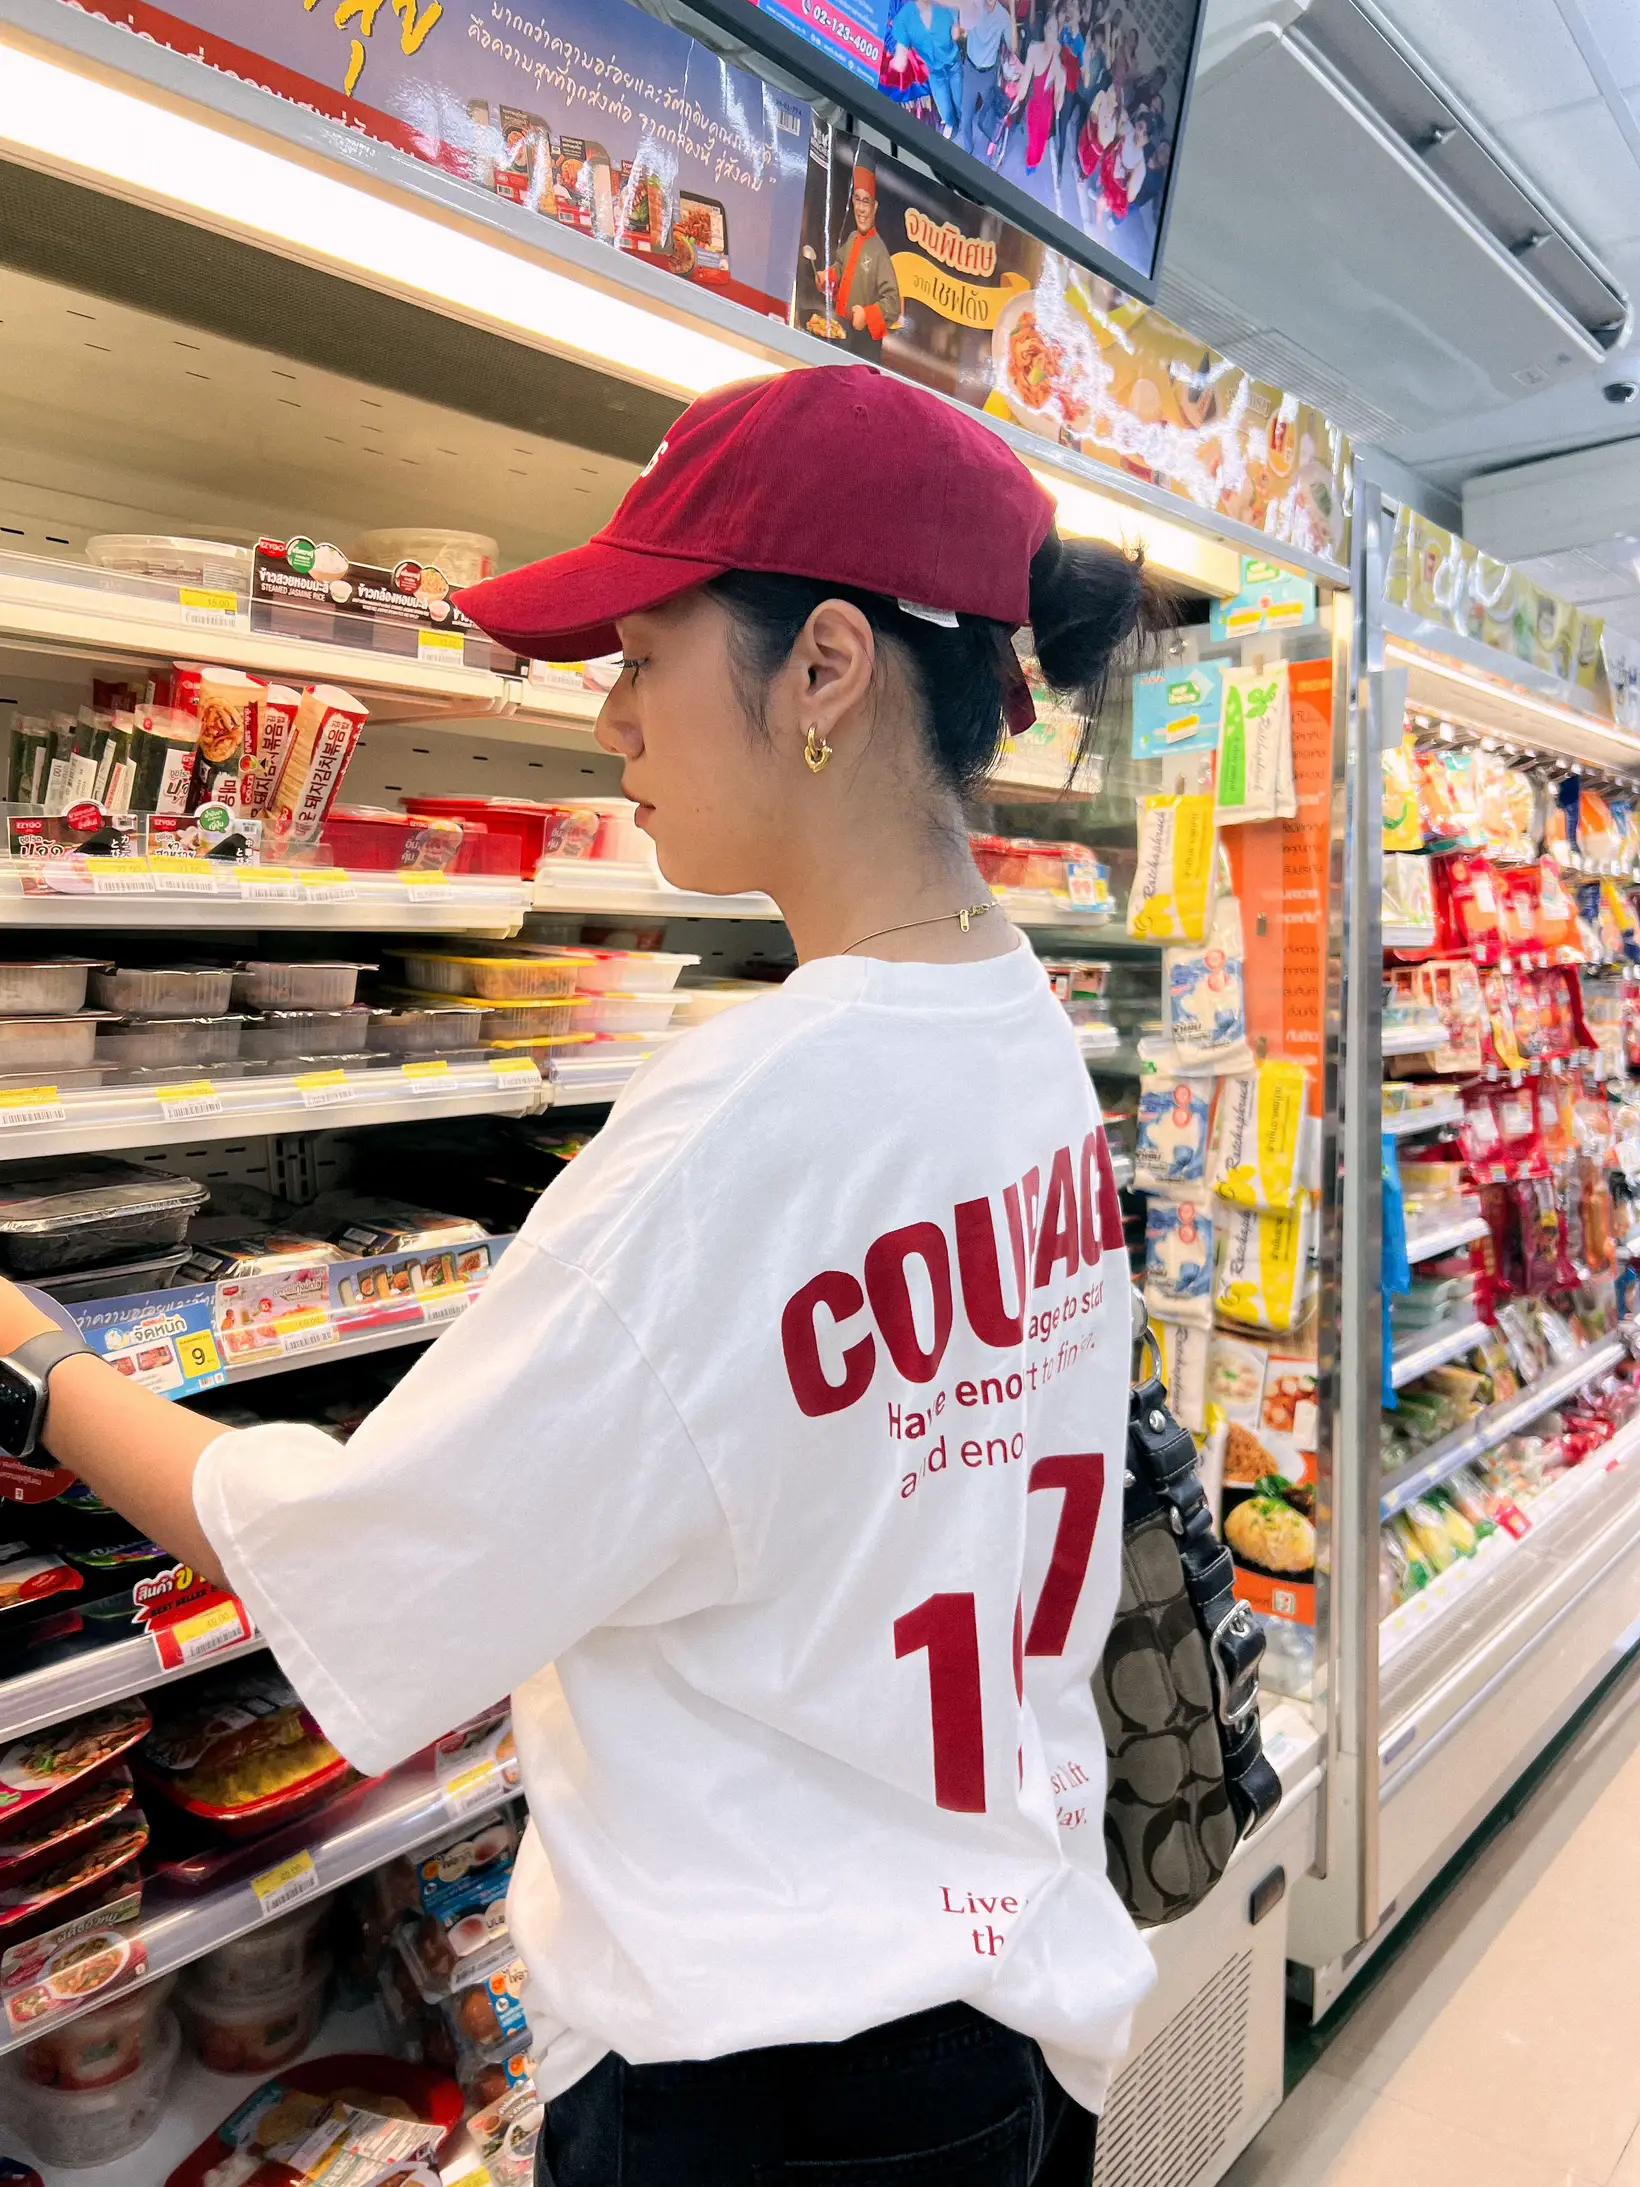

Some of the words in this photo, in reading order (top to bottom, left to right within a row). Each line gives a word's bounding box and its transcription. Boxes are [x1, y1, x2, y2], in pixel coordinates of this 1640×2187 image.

[813, 6, 879, 61] 02-123-4000
[907, 211, 995, 272] จานพิเศษ
[304, 728, 347, 810] 돼지김치볶음
[15, 821, 43, 830] EZYGO
[134, 1314, 187, 1343] จัดหนัก
[191, 1347, 206, 1366] 9
[954, 1373, 1024, 1407] eno
[960, 1432, 1024, 1468] eno
[937, 1885, 1020, 1915] Live
